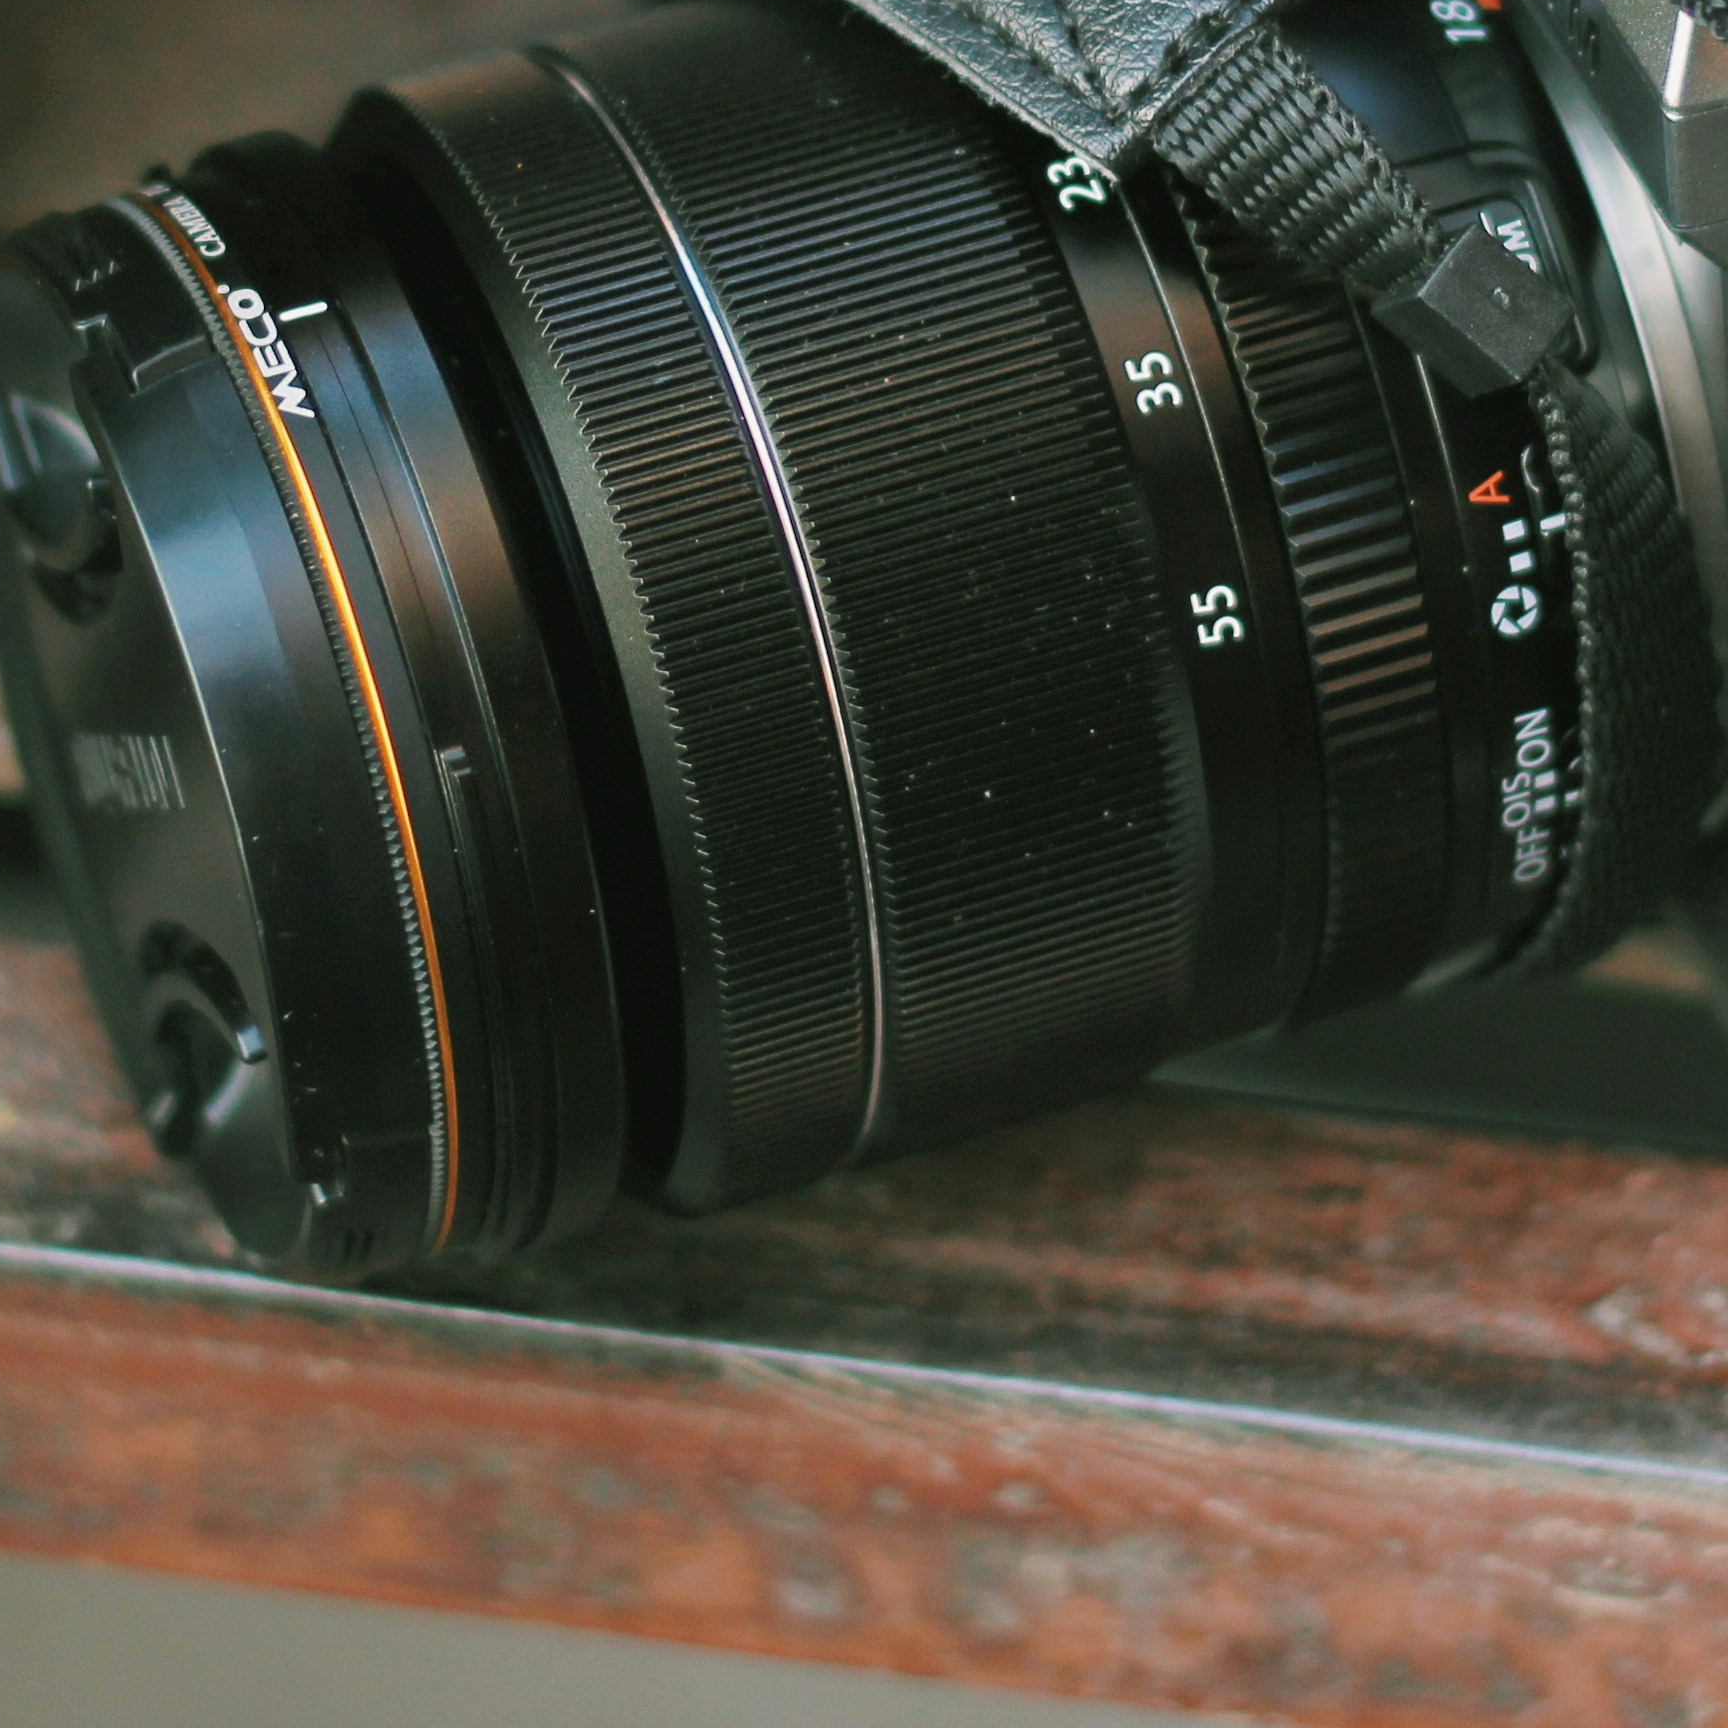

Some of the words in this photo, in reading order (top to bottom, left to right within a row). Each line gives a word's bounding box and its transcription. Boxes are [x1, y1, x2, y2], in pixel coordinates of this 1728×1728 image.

[1046, 155, 1107, 210] 23
[162, 194, 227, 258] CAMERA
[227, 288, 316, 419] MECO
[1123, 351, 1183, 415] 35
[1468, 470, 1512, 503] A
[1190, 584, 1243, 647] 55
[1514, 708, 1552, 769] ON
[1502, 772, 1532, 828] OIS
[1513, 826, 1551, 882] OFF
